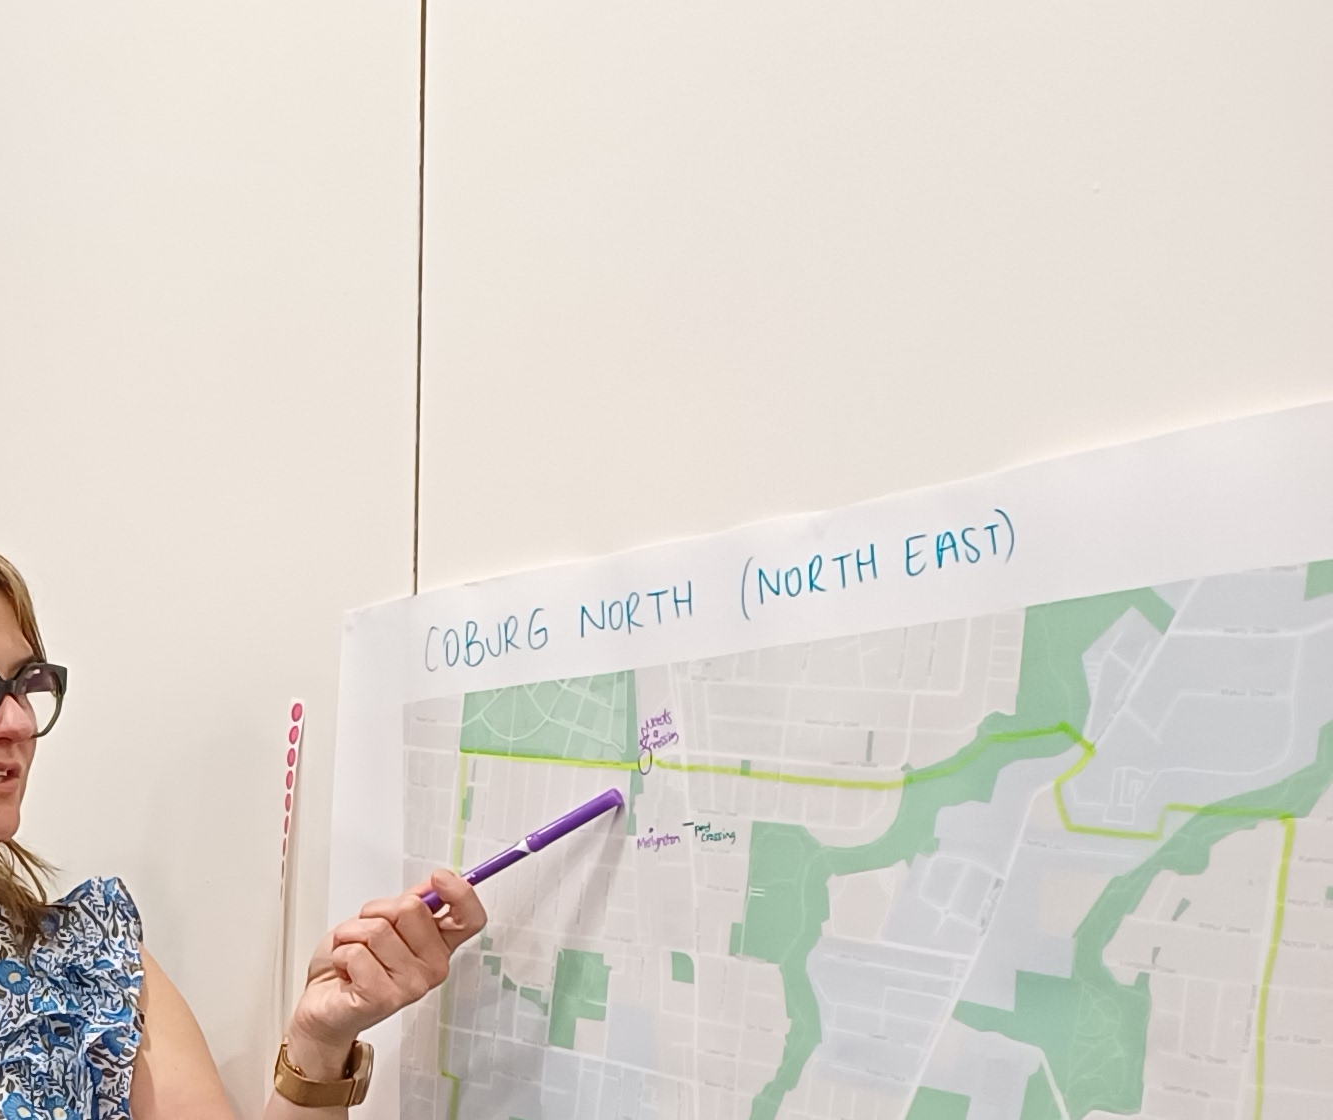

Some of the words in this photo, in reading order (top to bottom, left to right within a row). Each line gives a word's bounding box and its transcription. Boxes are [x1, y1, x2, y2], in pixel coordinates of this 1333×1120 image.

[424, 608, 549, 673] COBURG
[579, 580, 694, 638] NORTH
[740, 543, 879, 622] (NORTH
[904, 508, 1016, 577] EAST)
